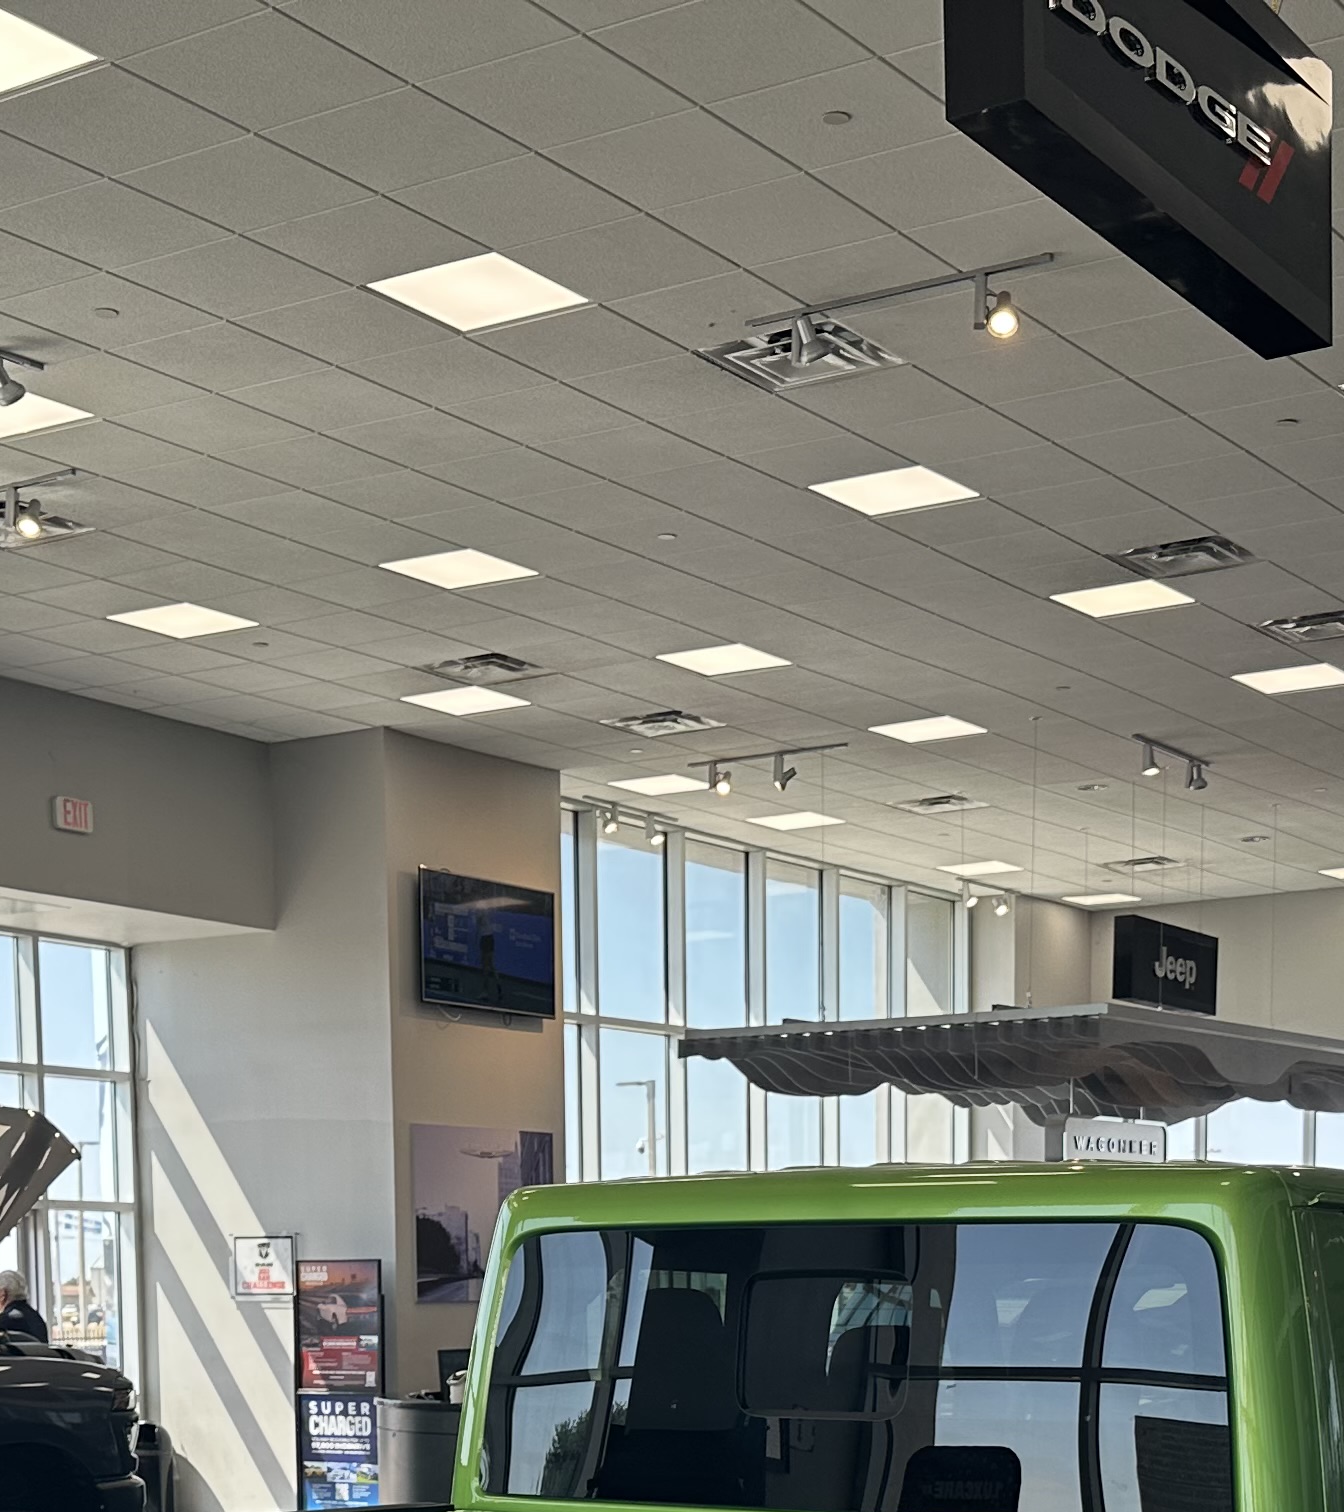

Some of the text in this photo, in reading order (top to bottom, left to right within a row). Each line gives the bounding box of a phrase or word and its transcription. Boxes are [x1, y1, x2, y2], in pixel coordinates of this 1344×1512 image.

[62, 798, 90, 830] EXIT
[1154, 946, 1197, 989] Jeep
[1073, 1135, 1158, 1156] WAGONEER
[308, 1401, 371, 1416] SUPER
[308, 1415, 372, 1437] CHARGED
